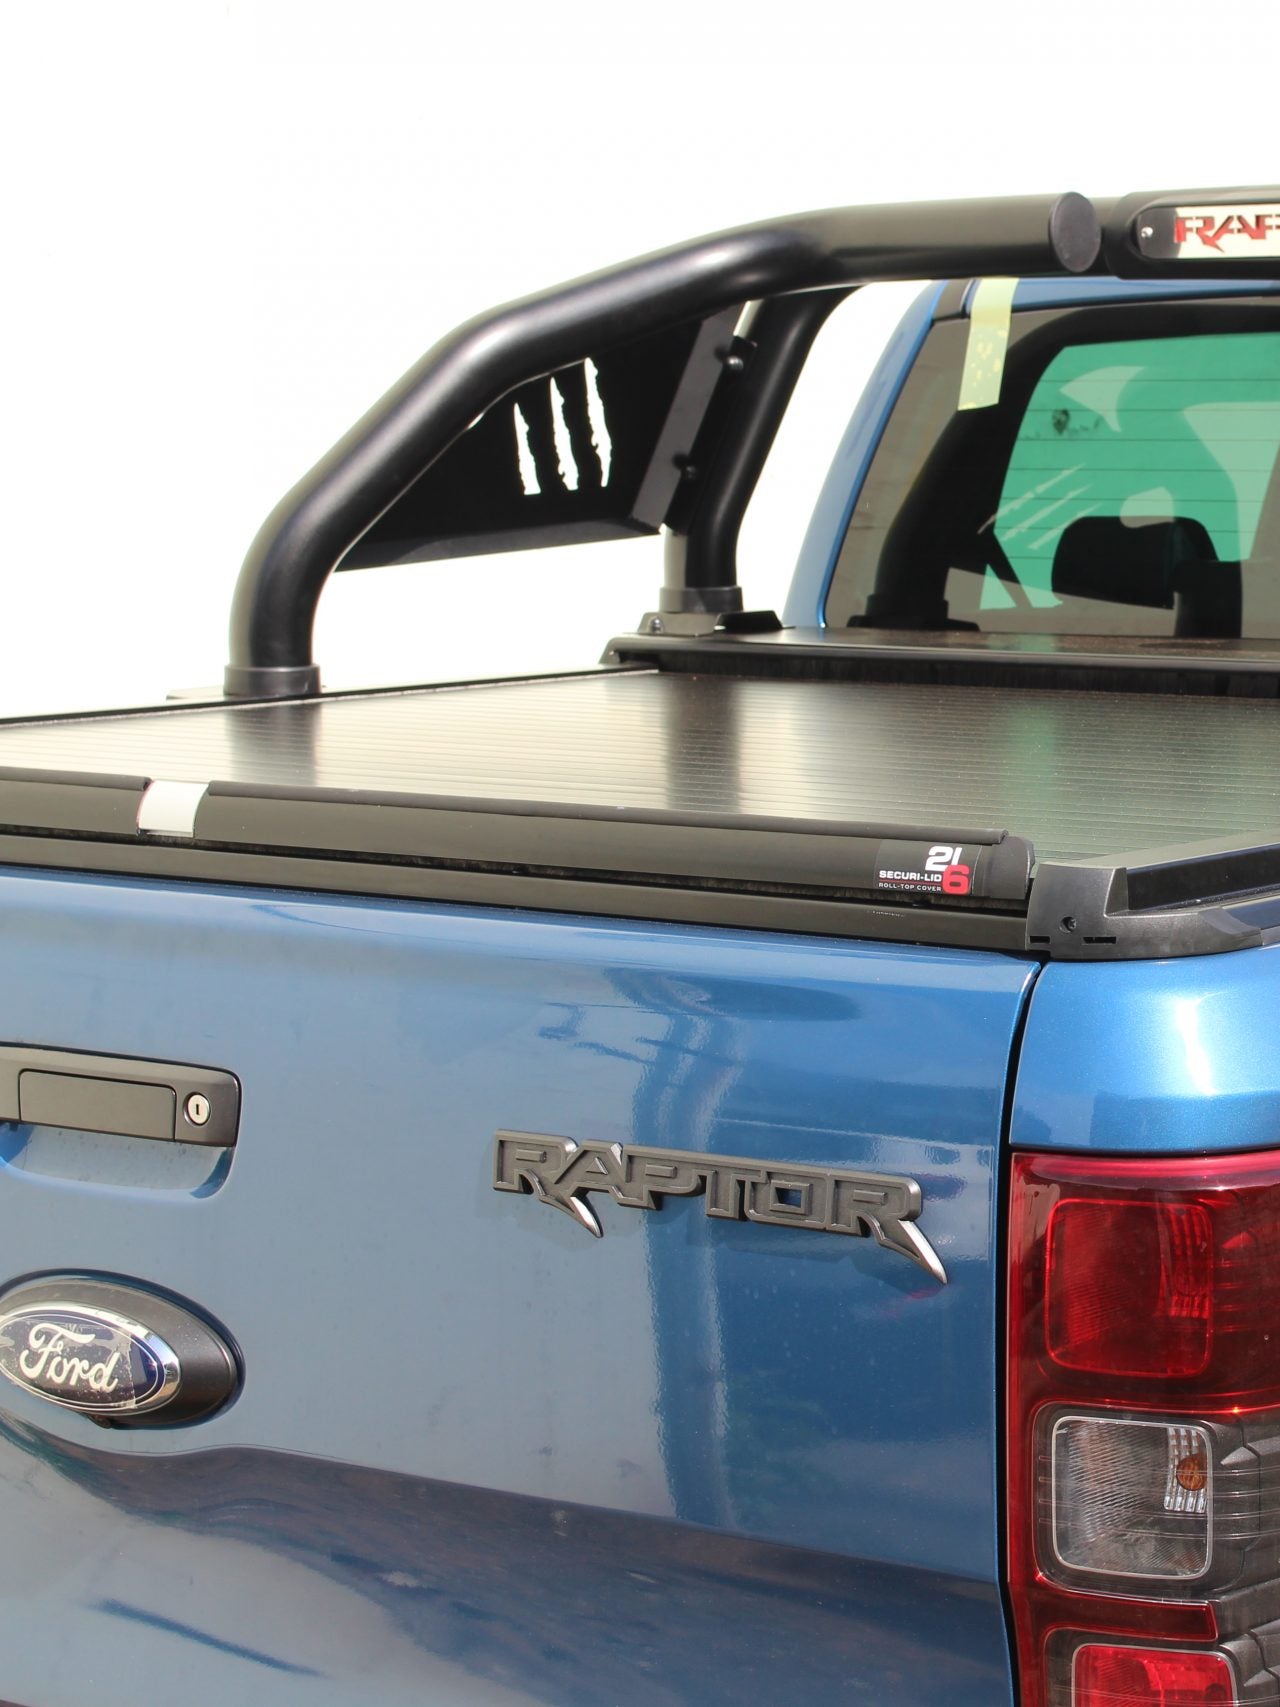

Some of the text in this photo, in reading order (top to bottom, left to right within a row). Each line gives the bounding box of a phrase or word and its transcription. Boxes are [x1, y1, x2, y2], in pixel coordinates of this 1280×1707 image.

[878, 882, 942, 892] ROLL-TOP COVER
[879, 870, 942, 882] SECURI-LID
[493, 1128, 948, 1286] RAPTOR
[19, 1322, 121, 1393] Ford
